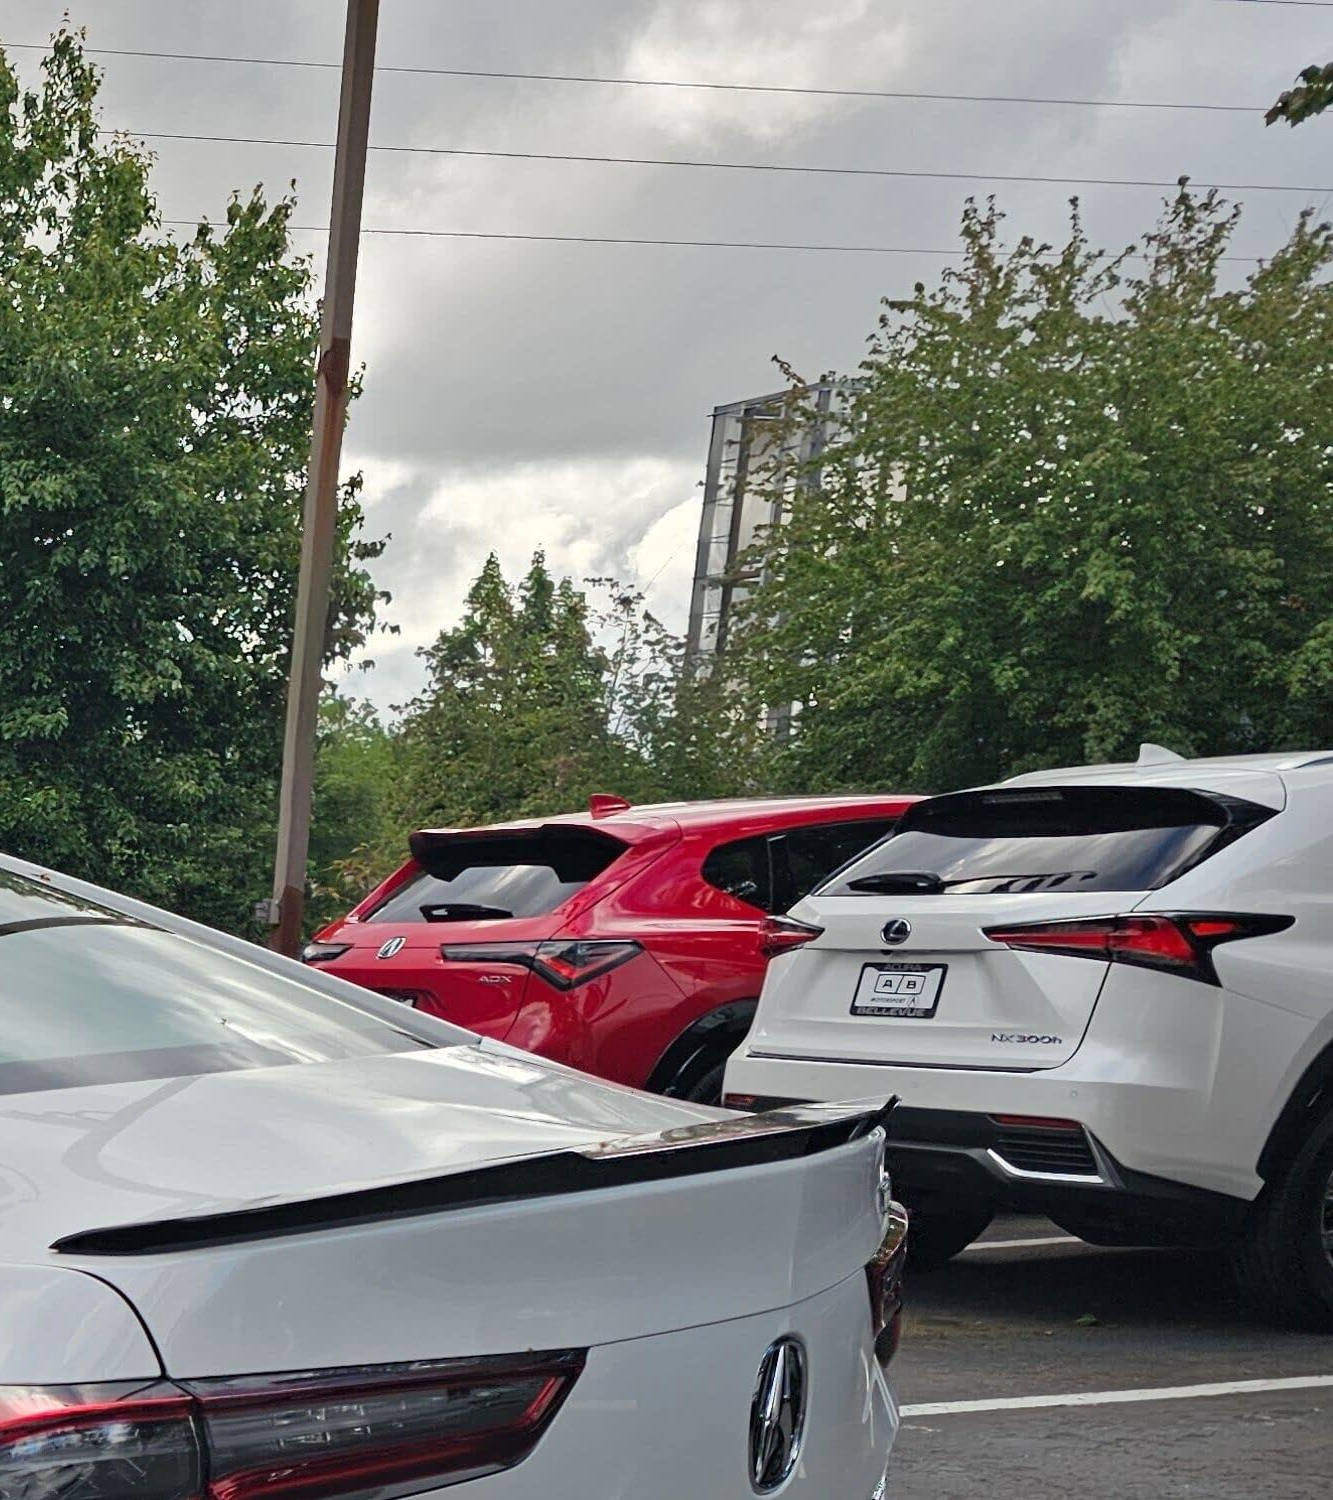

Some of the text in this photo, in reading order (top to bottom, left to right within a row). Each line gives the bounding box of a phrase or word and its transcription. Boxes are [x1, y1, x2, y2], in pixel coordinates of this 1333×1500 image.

[478, 975, 512, 983] ADX
[882, 979, 917, 990] A B
[856, 1006, 926, 1017] BELLEVUE
